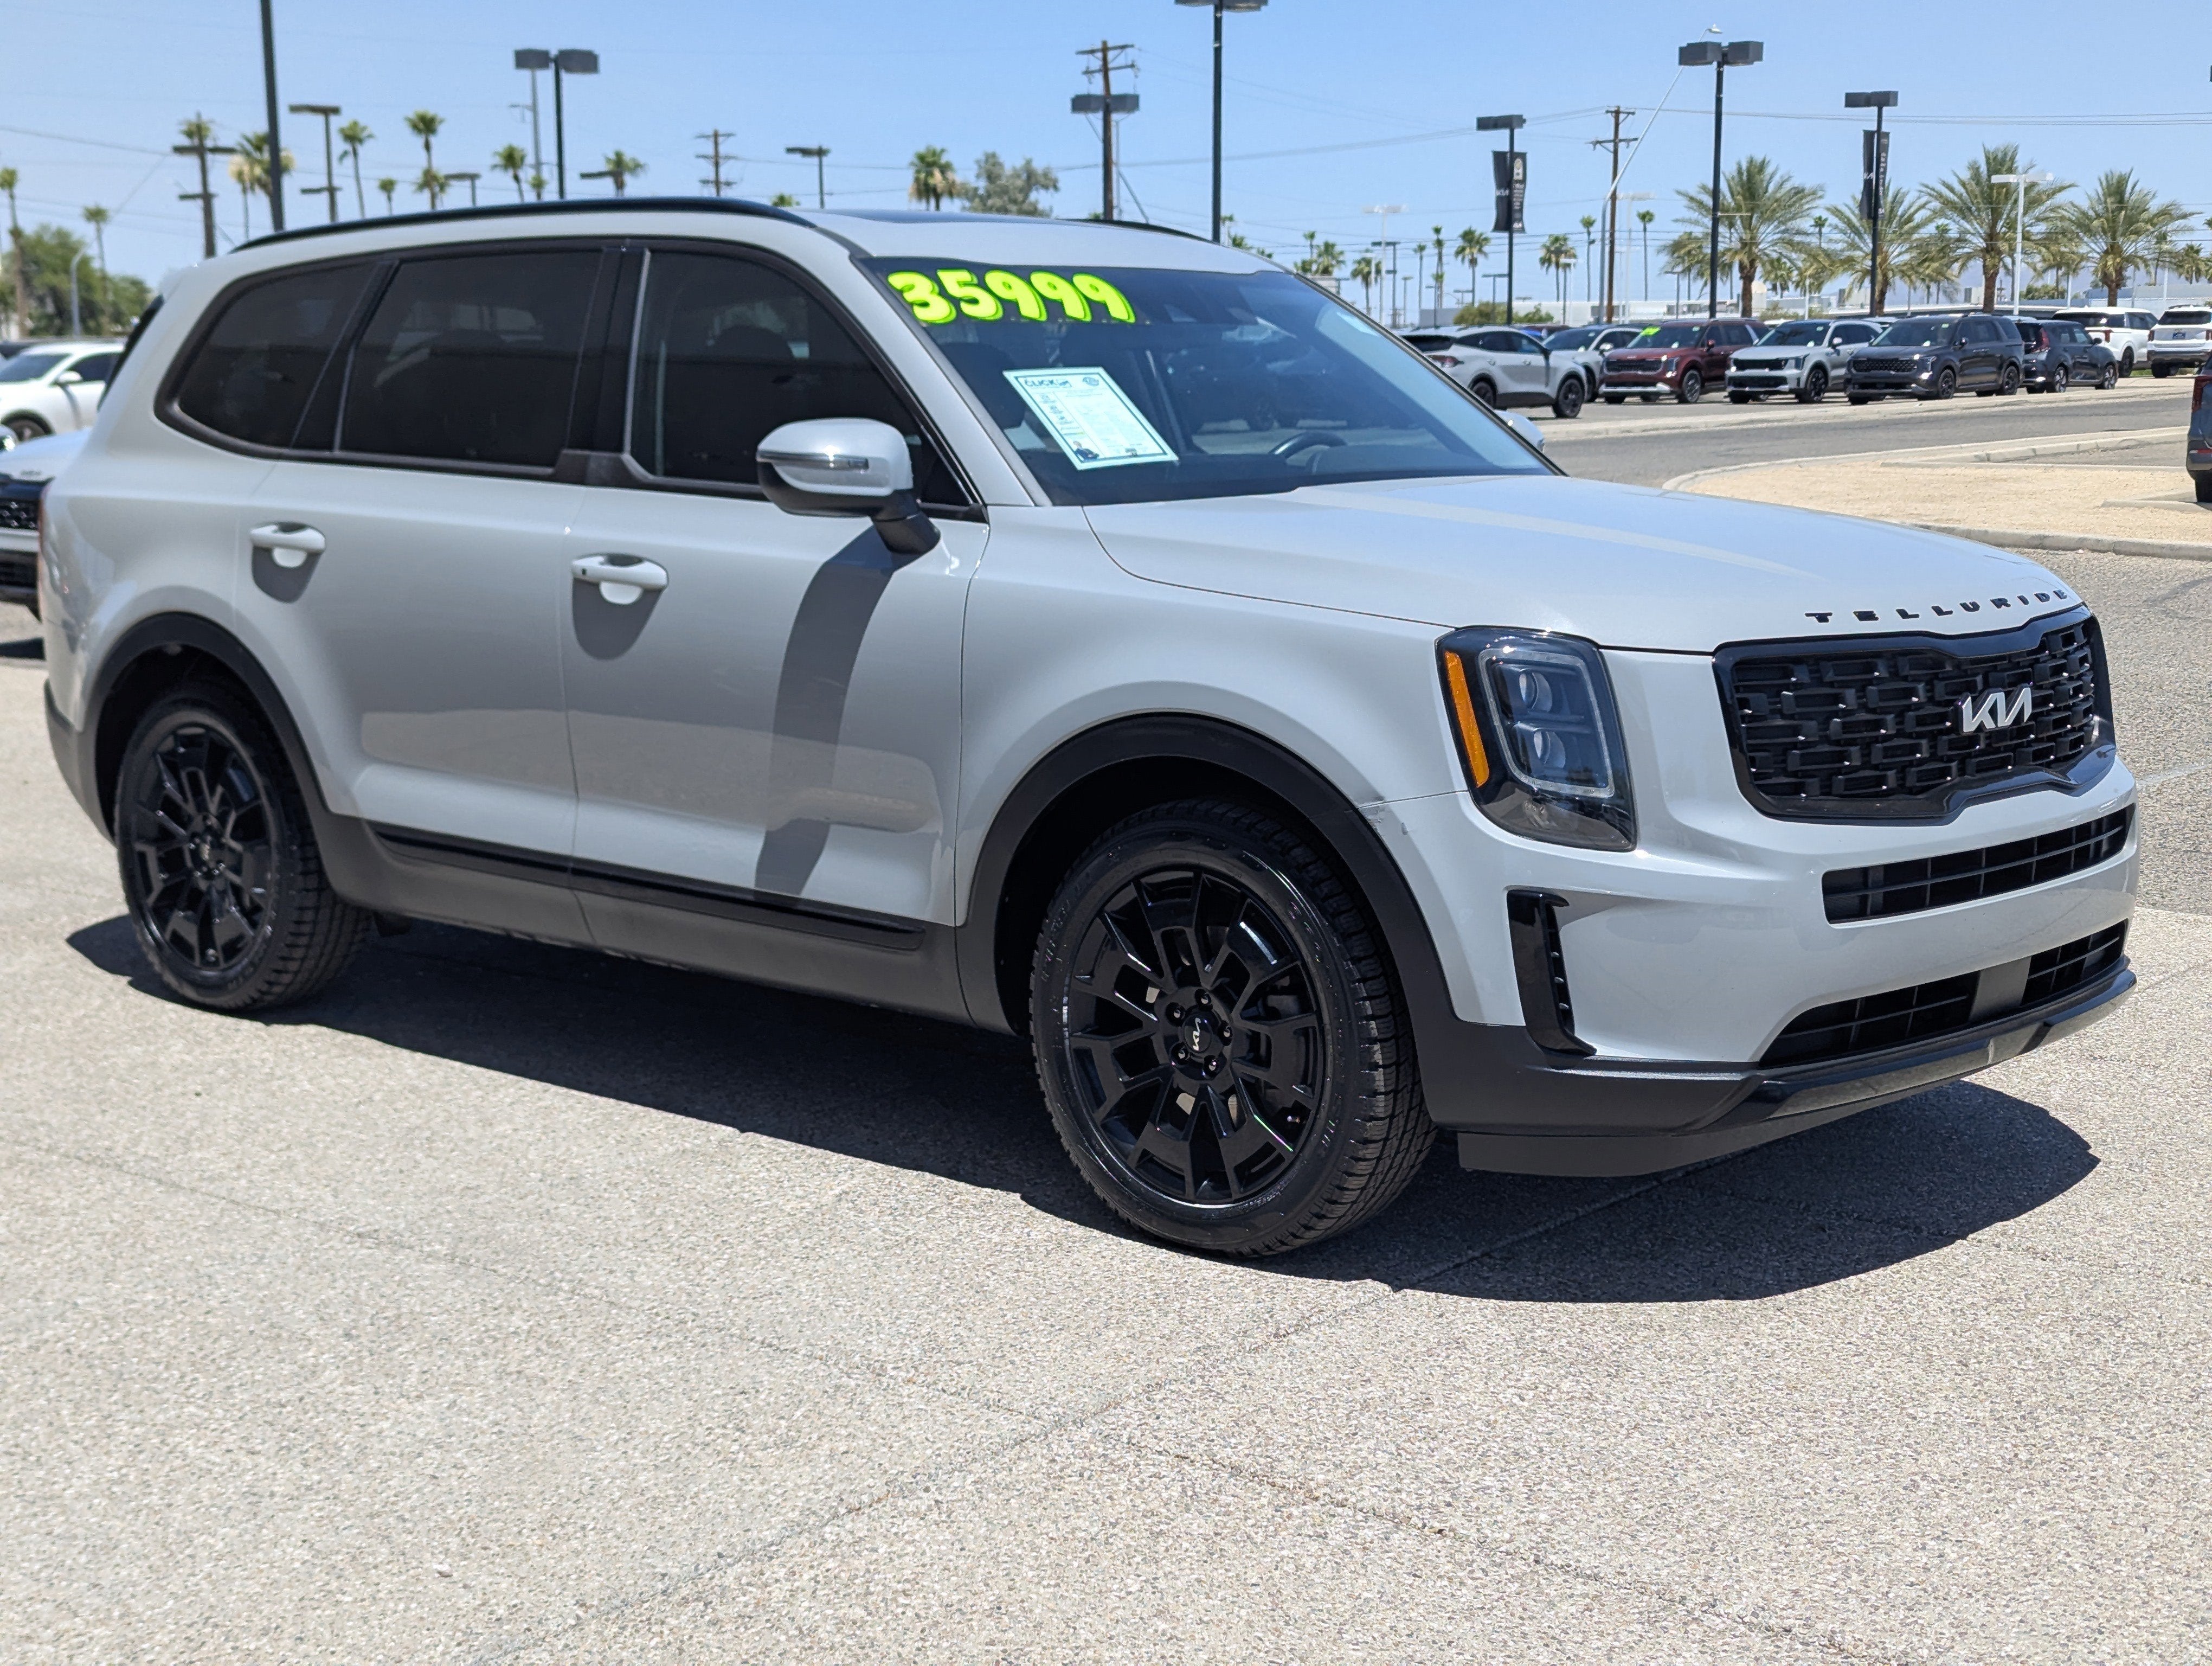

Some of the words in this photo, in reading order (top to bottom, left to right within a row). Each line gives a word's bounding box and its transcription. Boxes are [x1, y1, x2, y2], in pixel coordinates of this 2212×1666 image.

[888, 269, 1136, 324] 35999
[1804, 589, 2068, 623] TELLURIDE
[1961, 685, 2033, 733] KIA
